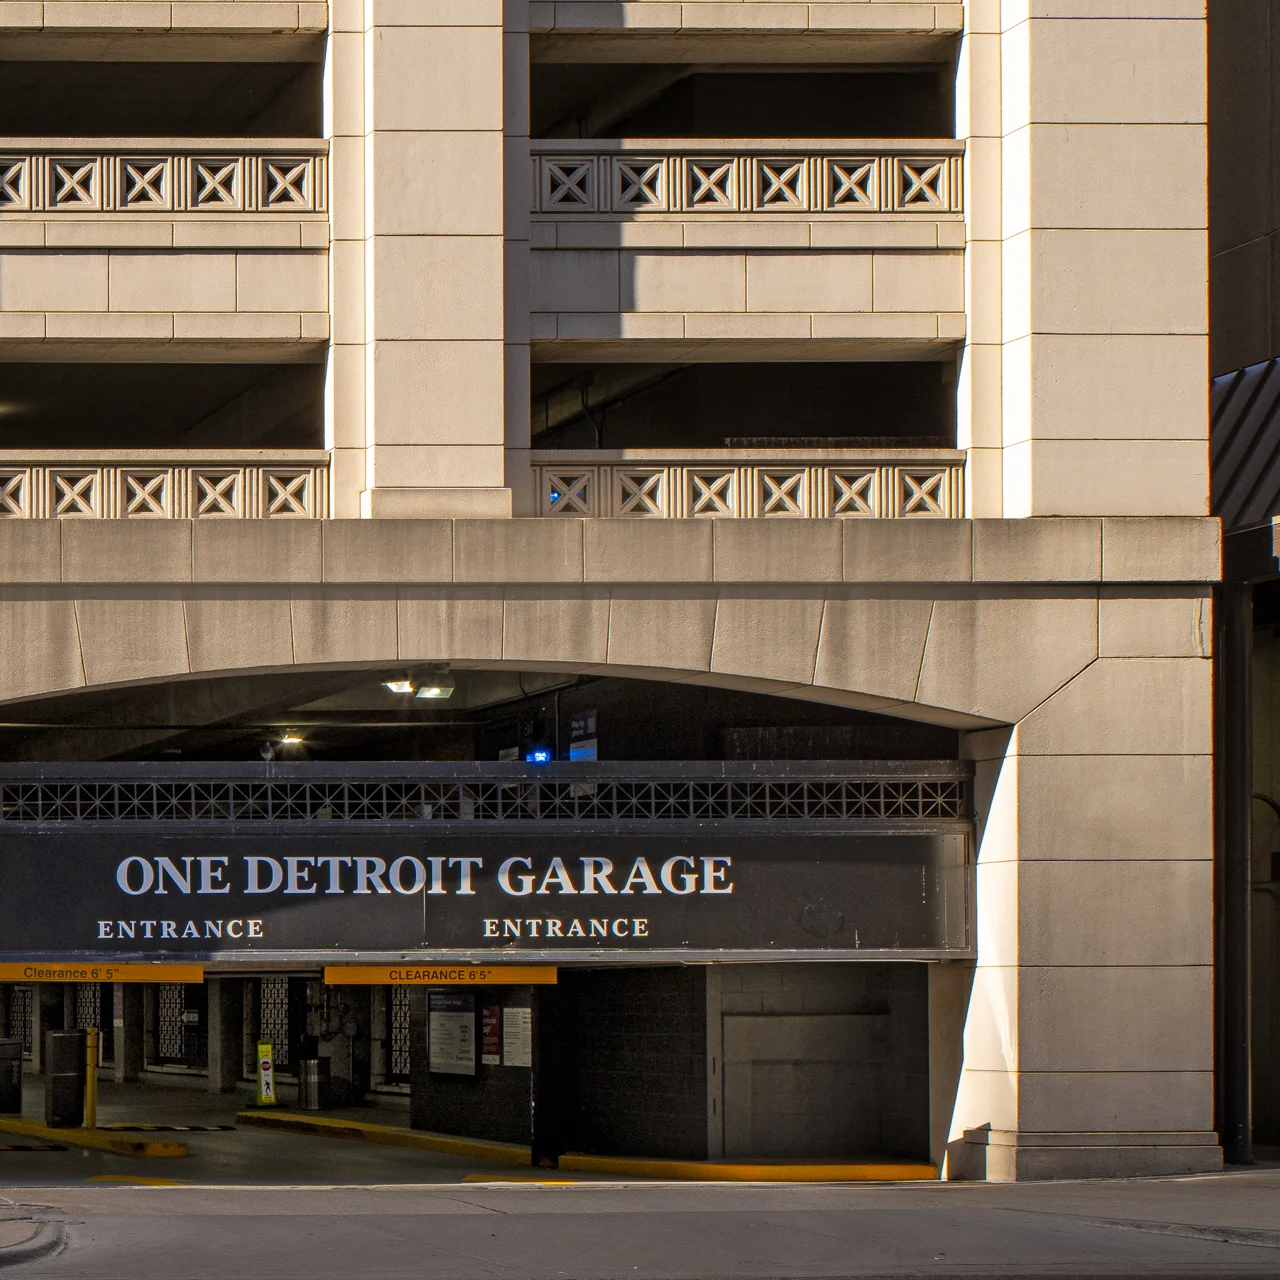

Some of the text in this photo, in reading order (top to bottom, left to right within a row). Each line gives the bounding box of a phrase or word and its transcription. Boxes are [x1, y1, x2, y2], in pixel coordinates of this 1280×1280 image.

[116, 855, 734, 895] ONE DETROIT GARAGE
[97, 919, 264, 939] ENTRANCE
[483, 918, 649, 937] ENTRANCE
[23, 967, 87, 979] Clearance
[389, 970, 465, 981] CLEARANCE
